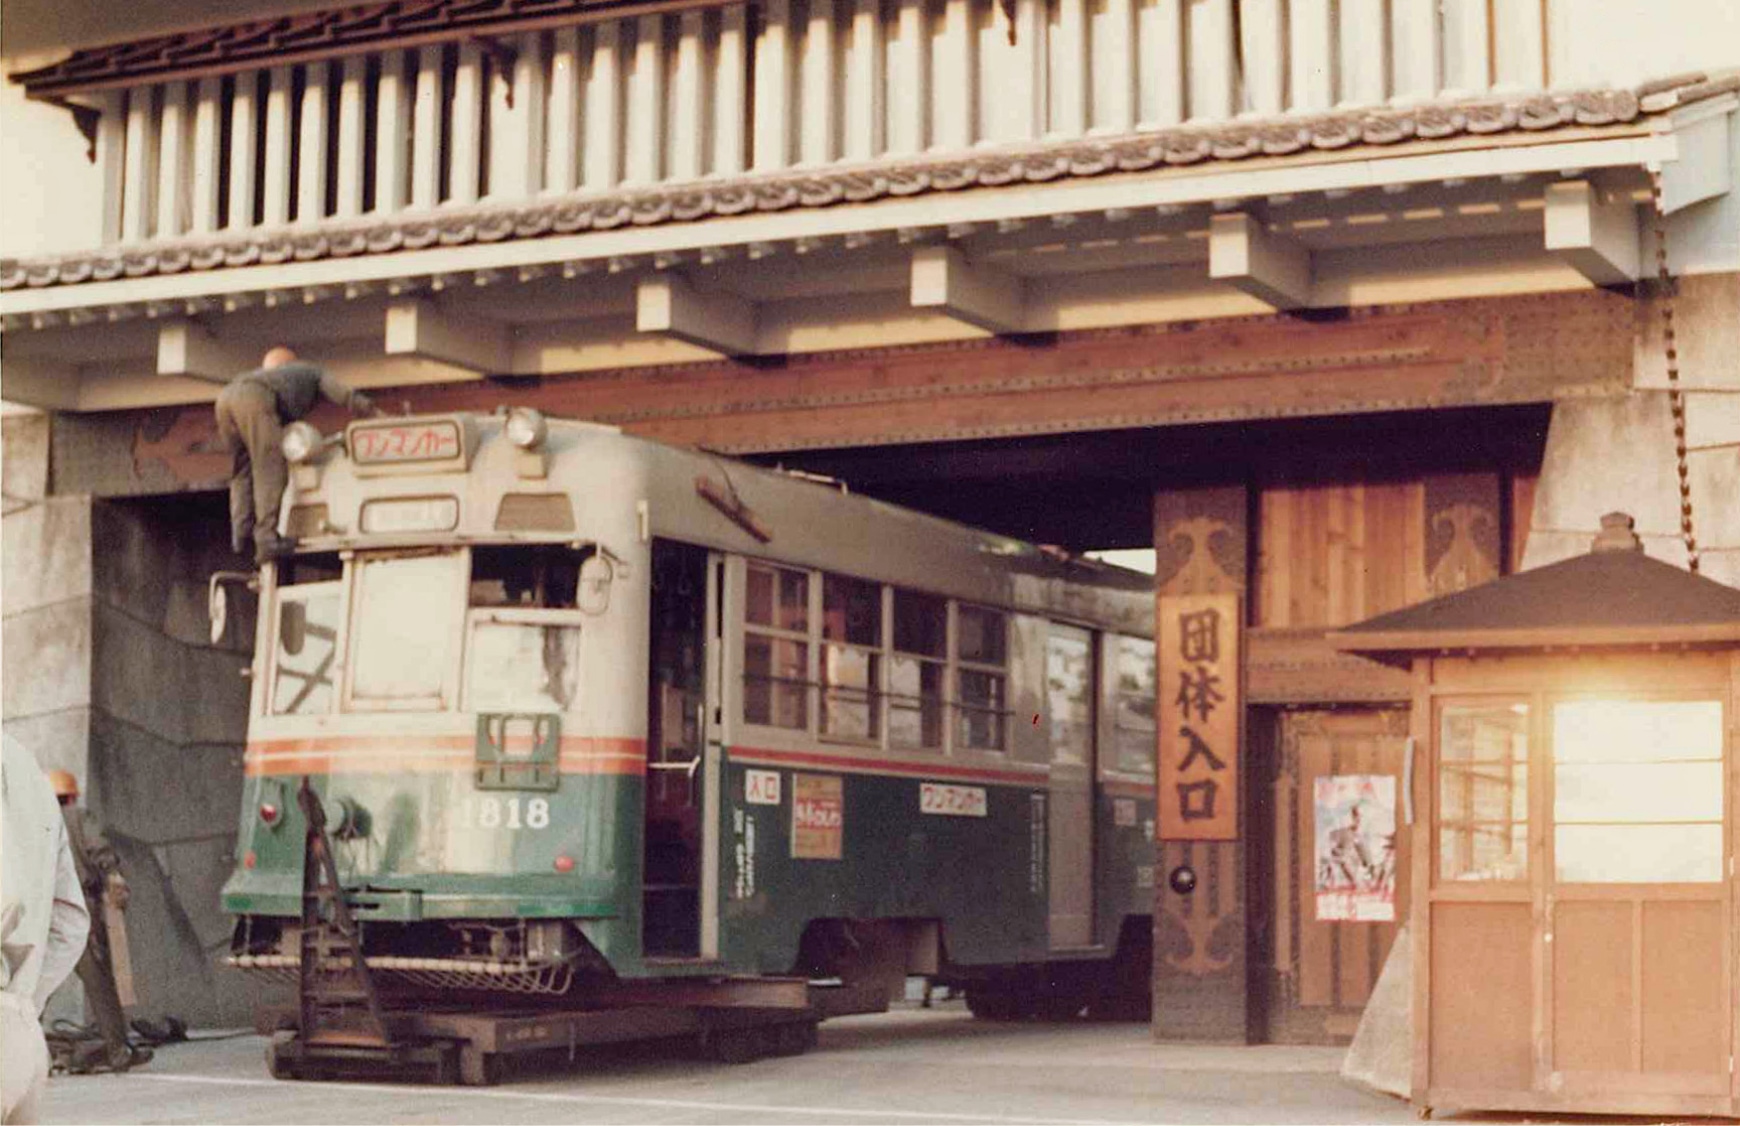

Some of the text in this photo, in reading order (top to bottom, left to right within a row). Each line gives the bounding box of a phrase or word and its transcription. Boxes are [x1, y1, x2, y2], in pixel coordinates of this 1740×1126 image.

[354, 426, 456, 457] ワンマンカー
[1175, 607, 1226, 822] 団体入口
[749, 775, 777, 801] 入口
[459, 798, 550, 829] 1818
